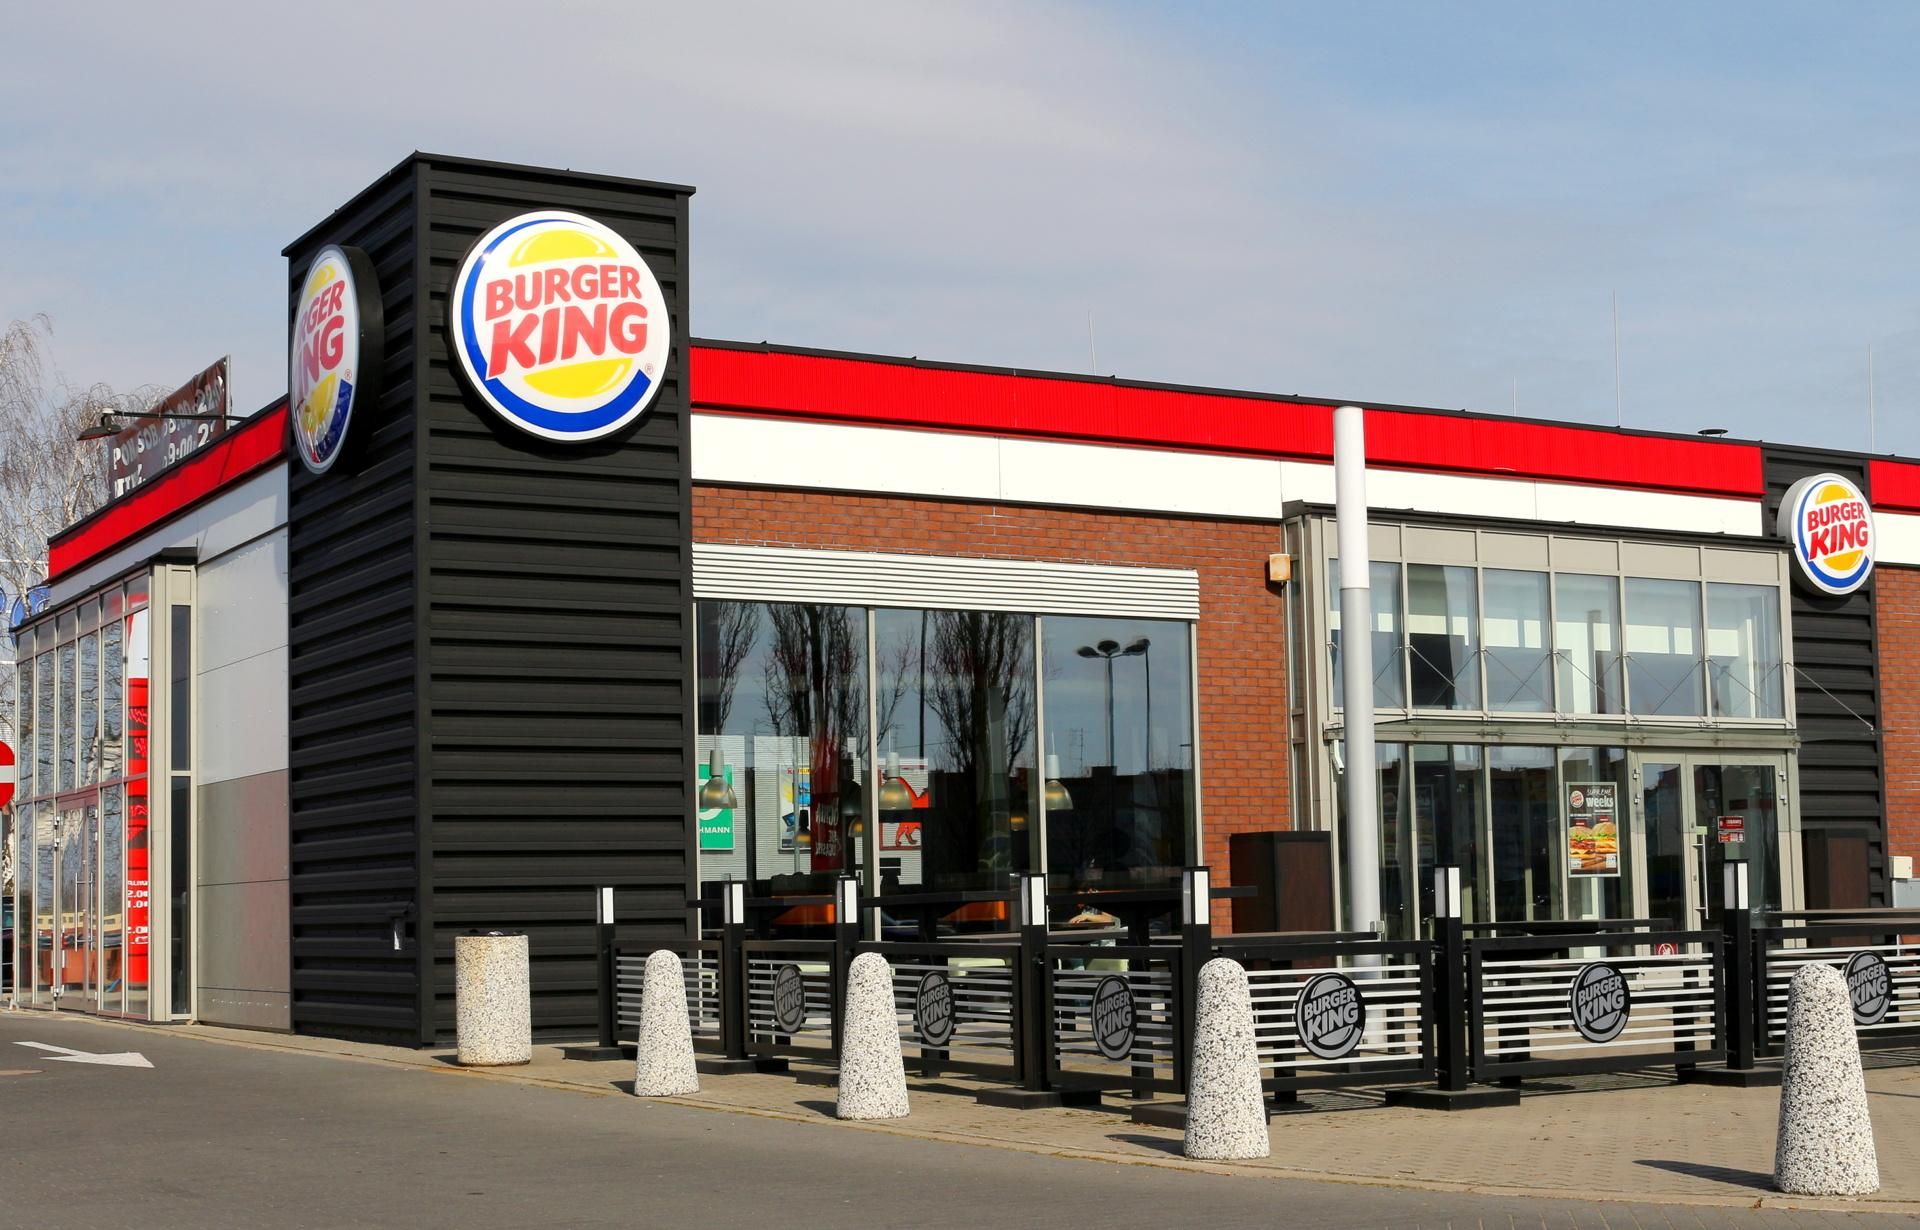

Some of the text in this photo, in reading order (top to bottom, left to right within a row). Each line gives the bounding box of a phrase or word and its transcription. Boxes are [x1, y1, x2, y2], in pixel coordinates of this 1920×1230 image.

[486, 265, 642, 321] BURGER
[298, 280, 345, 341] RGER
[297, 315, 345, 398] ING
[488, 302, 648, 378] KING
[1807, 502, 1865, 532] BURGER
[1809, 520, 1868, 560] KING
[1585, 795, 1614, 807] weeks
[777, 977, 800, 999] BURGER
[1578, 975, 1622, 1007] BURGER
[1848, 963, 1885, 991] BURGER
[1850, 976, 1887, 1009] KING
[778, 988, 801, 1018] KING
[920, 984, 949, 1007] BURGER
[1096, 991, 1130, 1020] BURGER
[1304, 987, 1356, 1021] BURGER
[1580, 989, 1624, 1026] KING
[922, 998, 950, 1028] KING
[1098, 1005, 1132, 1041] KING
[1307, 1002, 1358, 1042] KING
